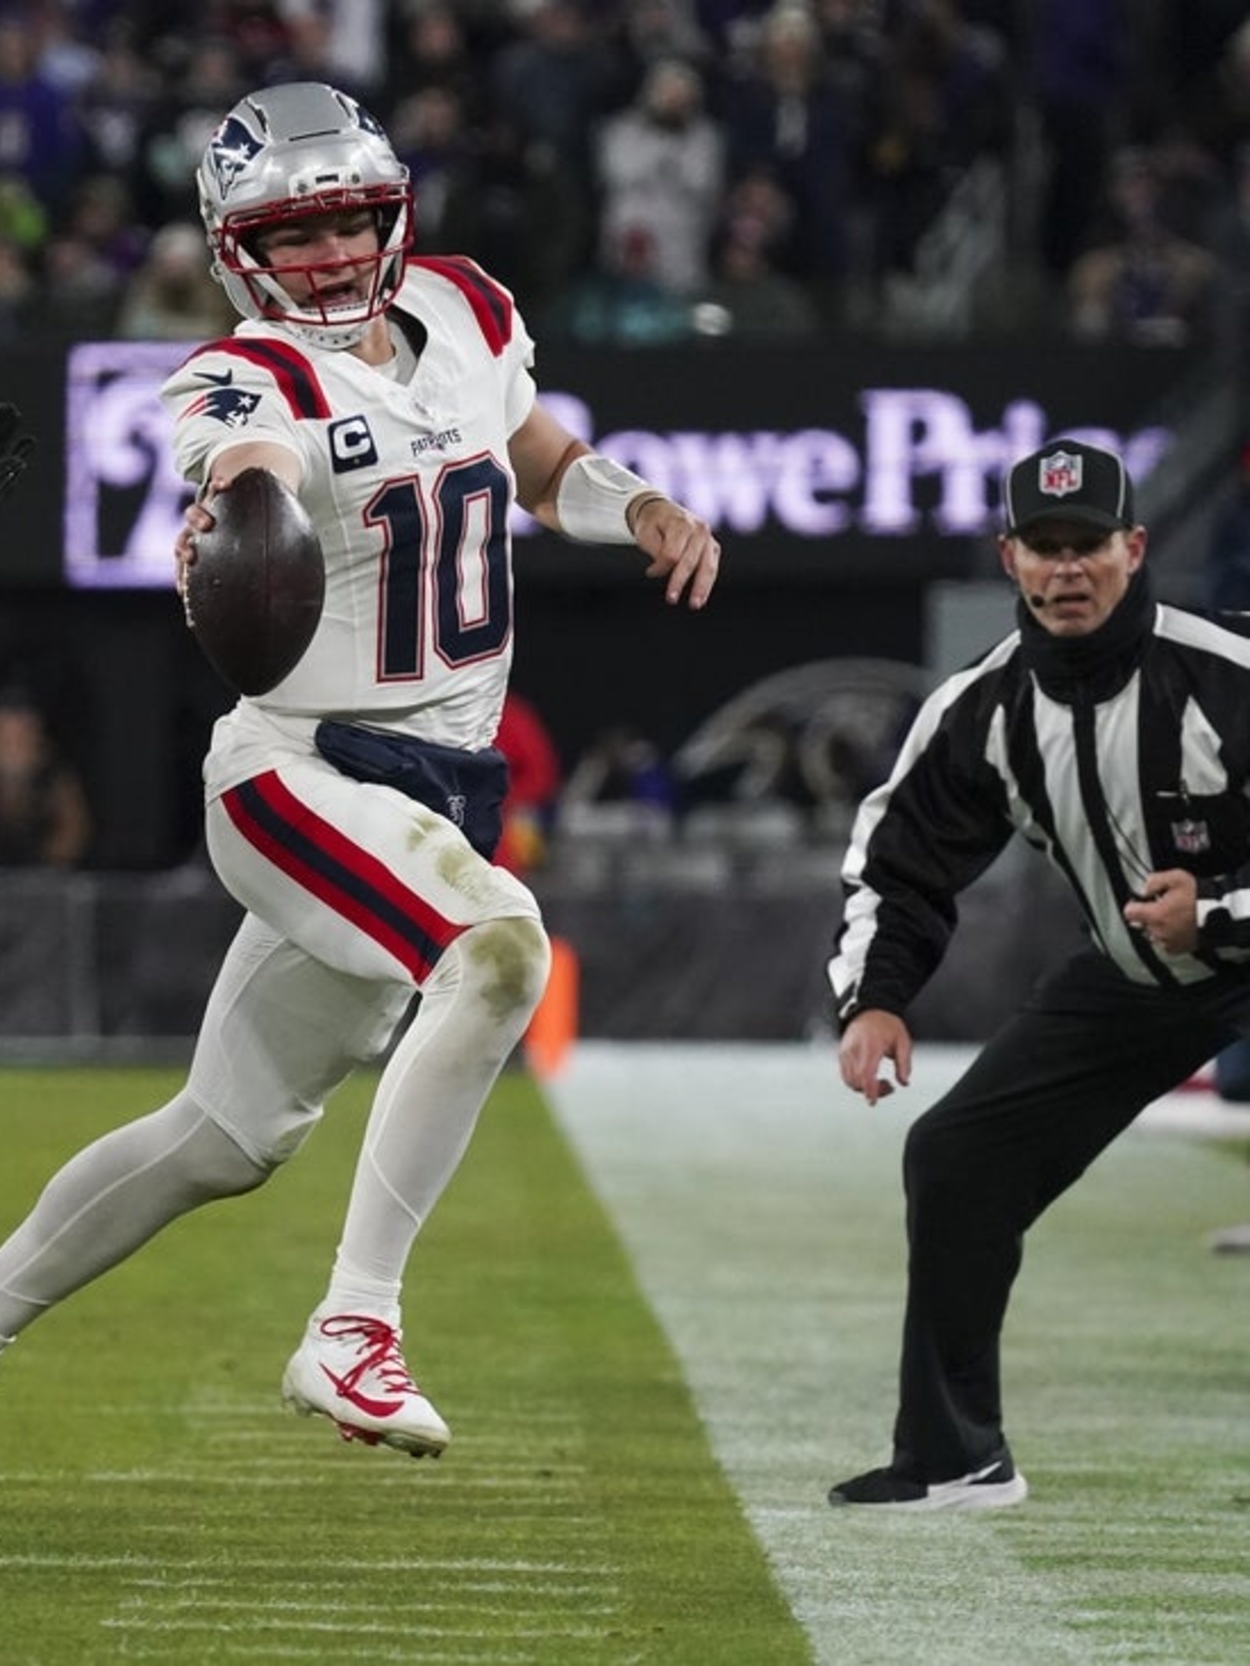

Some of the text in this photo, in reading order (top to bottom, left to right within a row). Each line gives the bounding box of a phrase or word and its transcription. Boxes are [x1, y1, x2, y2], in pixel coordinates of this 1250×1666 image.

[333, 421, 371, 460] C
[410, 428, 463, 457] PATRIOTS
[1044, 468, 1077, 489] NFL
[362, 450, 513, 684] 10
